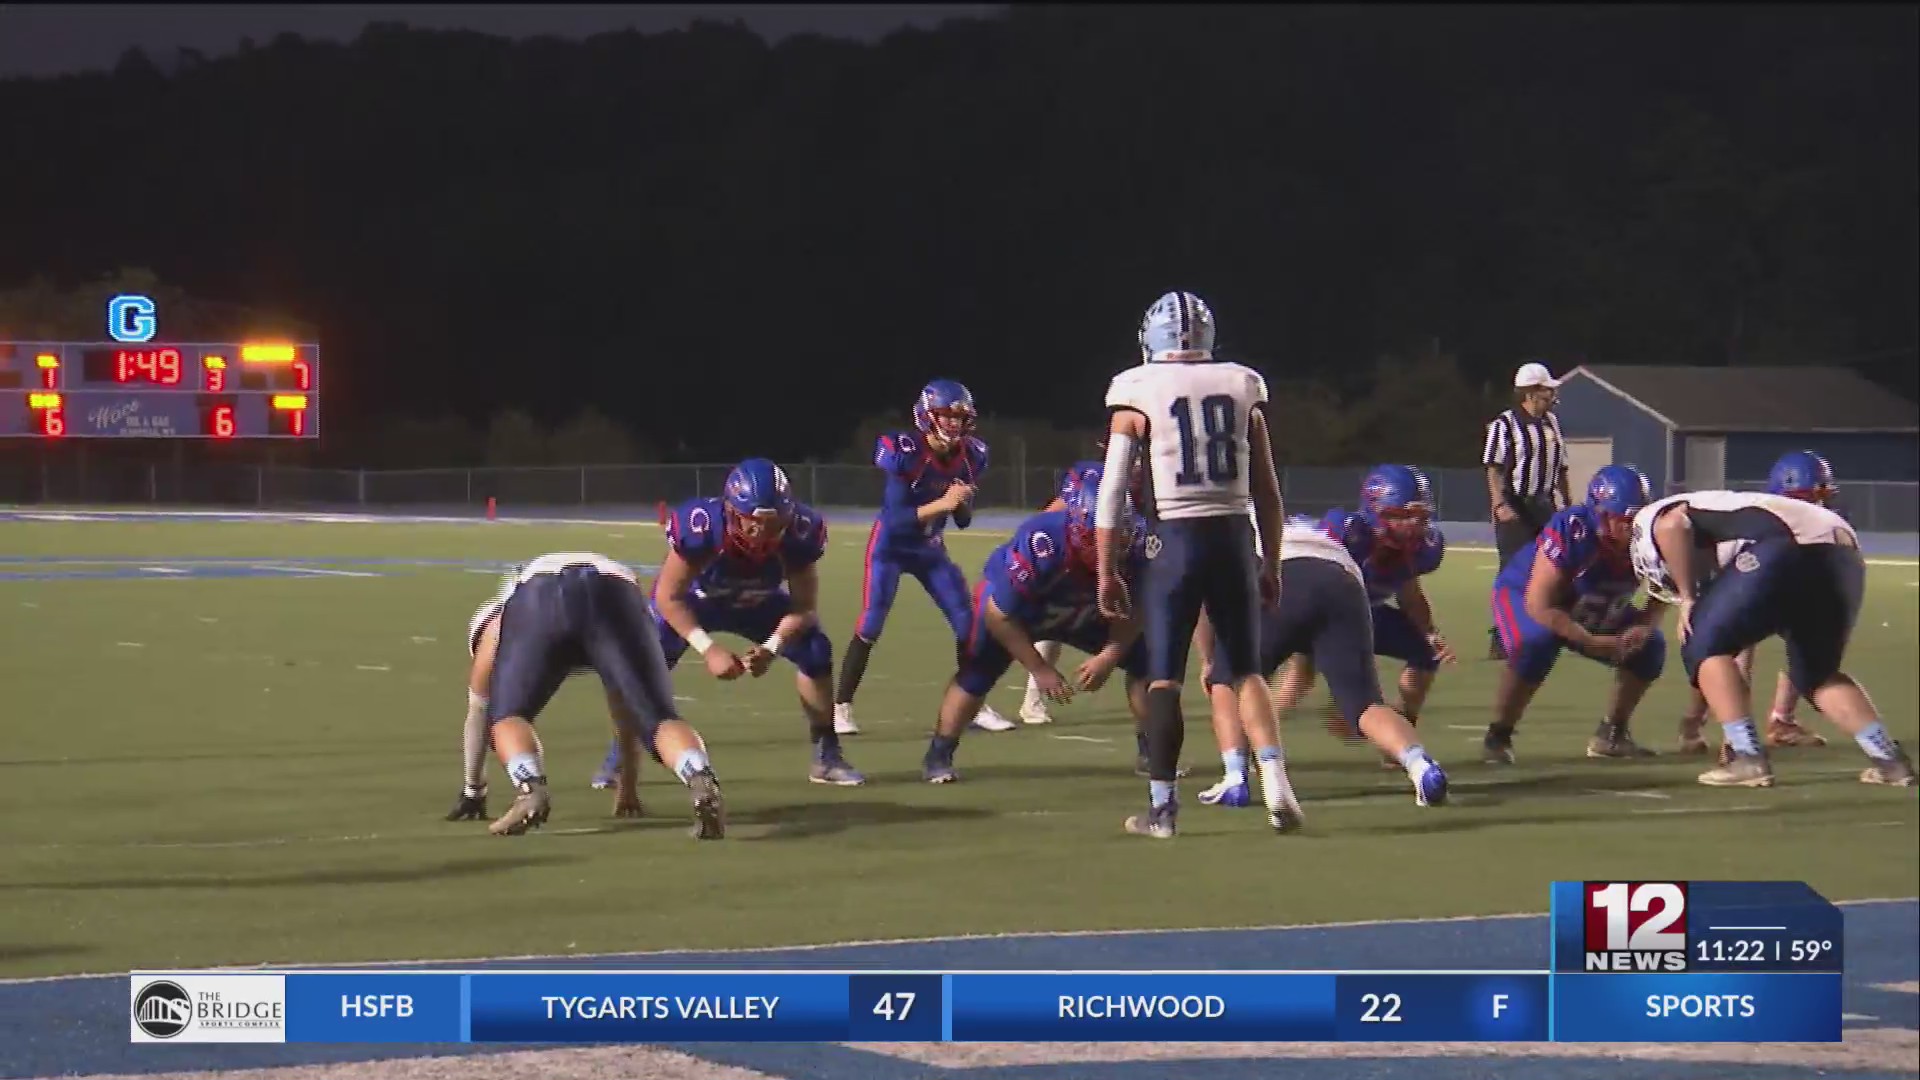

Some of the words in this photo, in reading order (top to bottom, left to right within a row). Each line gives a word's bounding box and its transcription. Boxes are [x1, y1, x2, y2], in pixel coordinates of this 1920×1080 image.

[109, 295, 157, 343] G
[116, 350, 180, 383] 1:49
[209, 369, 223, 393] 3
[293, 363, 309, 390] 7
[45, 408, 64, 436] 6
[215, 407, 234, 436] 6
[1169, 394, 1239, 486] 18
